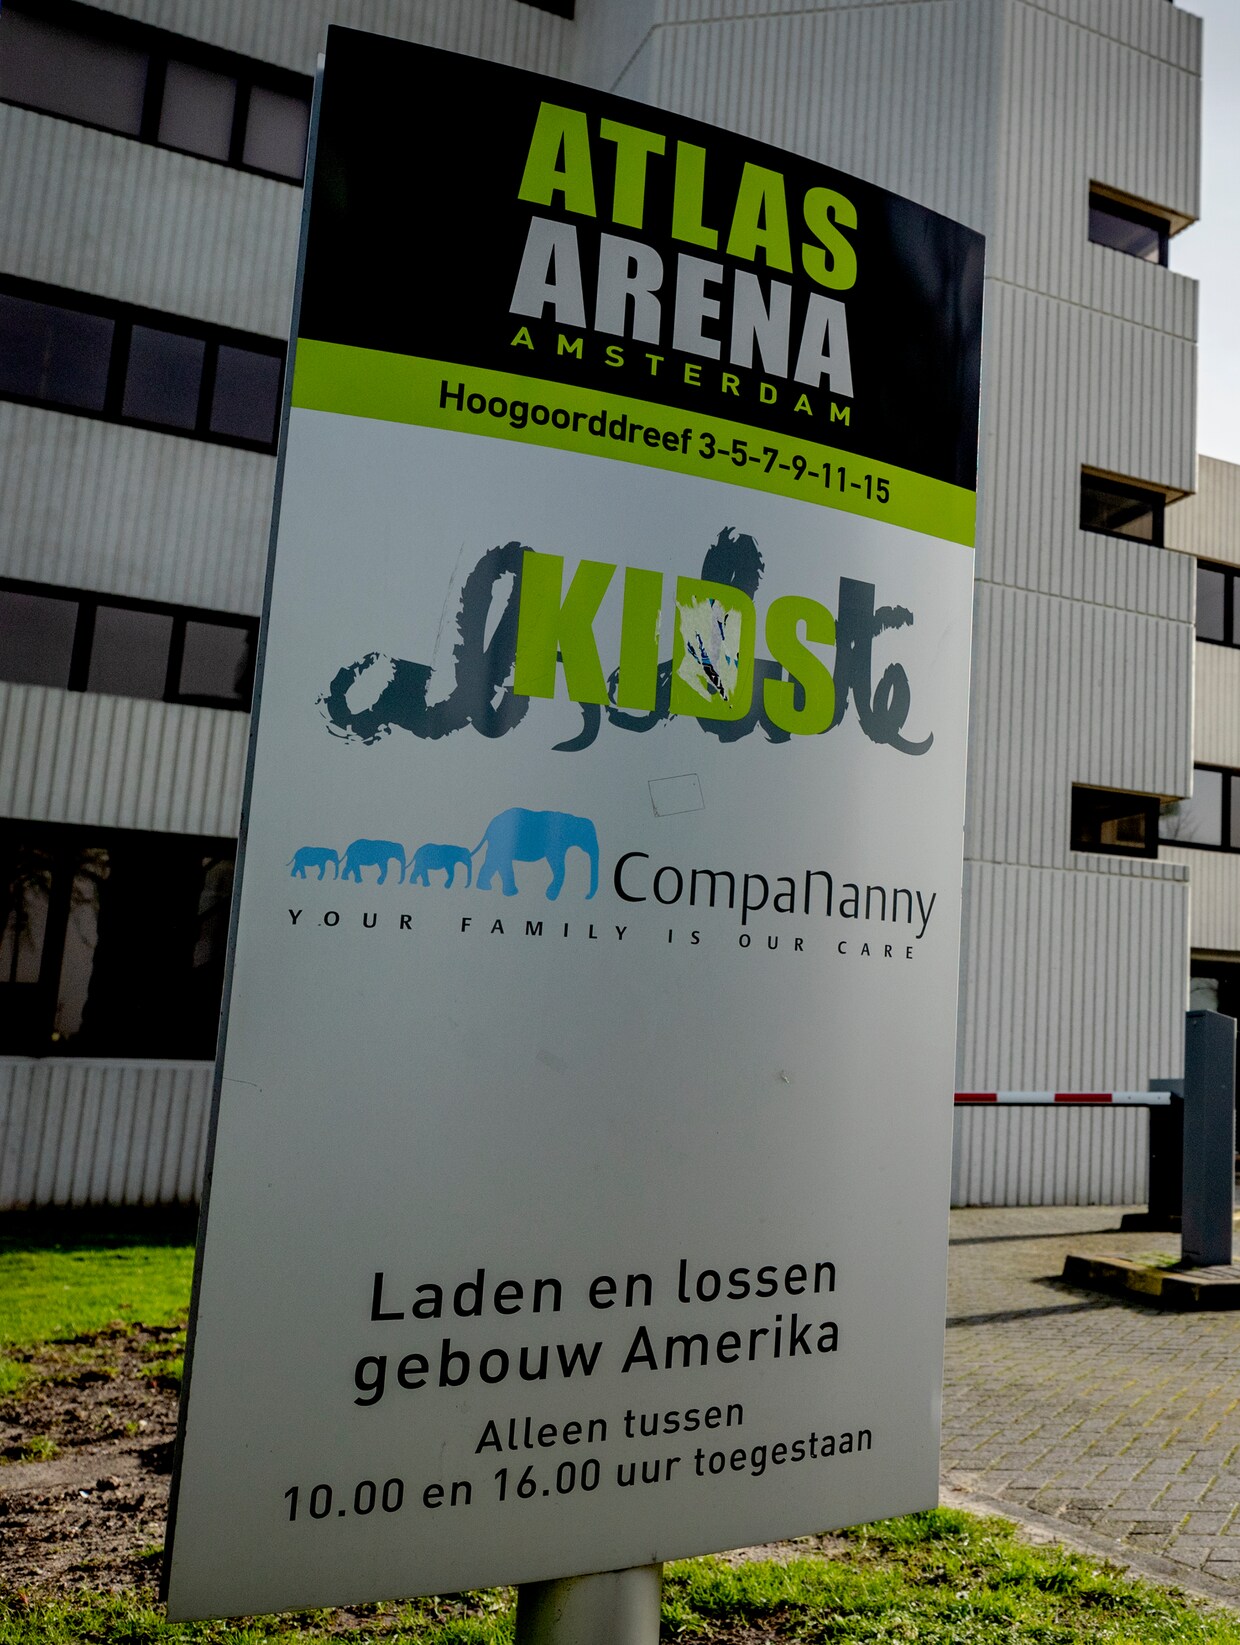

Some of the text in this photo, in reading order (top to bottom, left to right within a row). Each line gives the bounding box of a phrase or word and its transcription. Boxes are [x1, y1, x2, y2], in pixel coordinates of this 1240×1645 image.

[517, 101, 858, 291] ATLAS
[508, 215, 855, 398] ARENA
[510, 326, 852, 427] AMSTERDAM
[438, 380, 891, 505] Hoogoorddreef 3-5-7-9-11-15
[512, 550, 838, 737] KIDS
[287, 908, 914, 961] YOUR FAMILY IS OUR CARE
[370, 1258, 838, 1322] Laden en lossen
[353, 1312, 840, 1407] gebouw Amerika
[284, 1426, 873, 1522] 10.00 en 16.00 uur toegestaan
[475, 1402, 745, 1455] Alleen tussen
